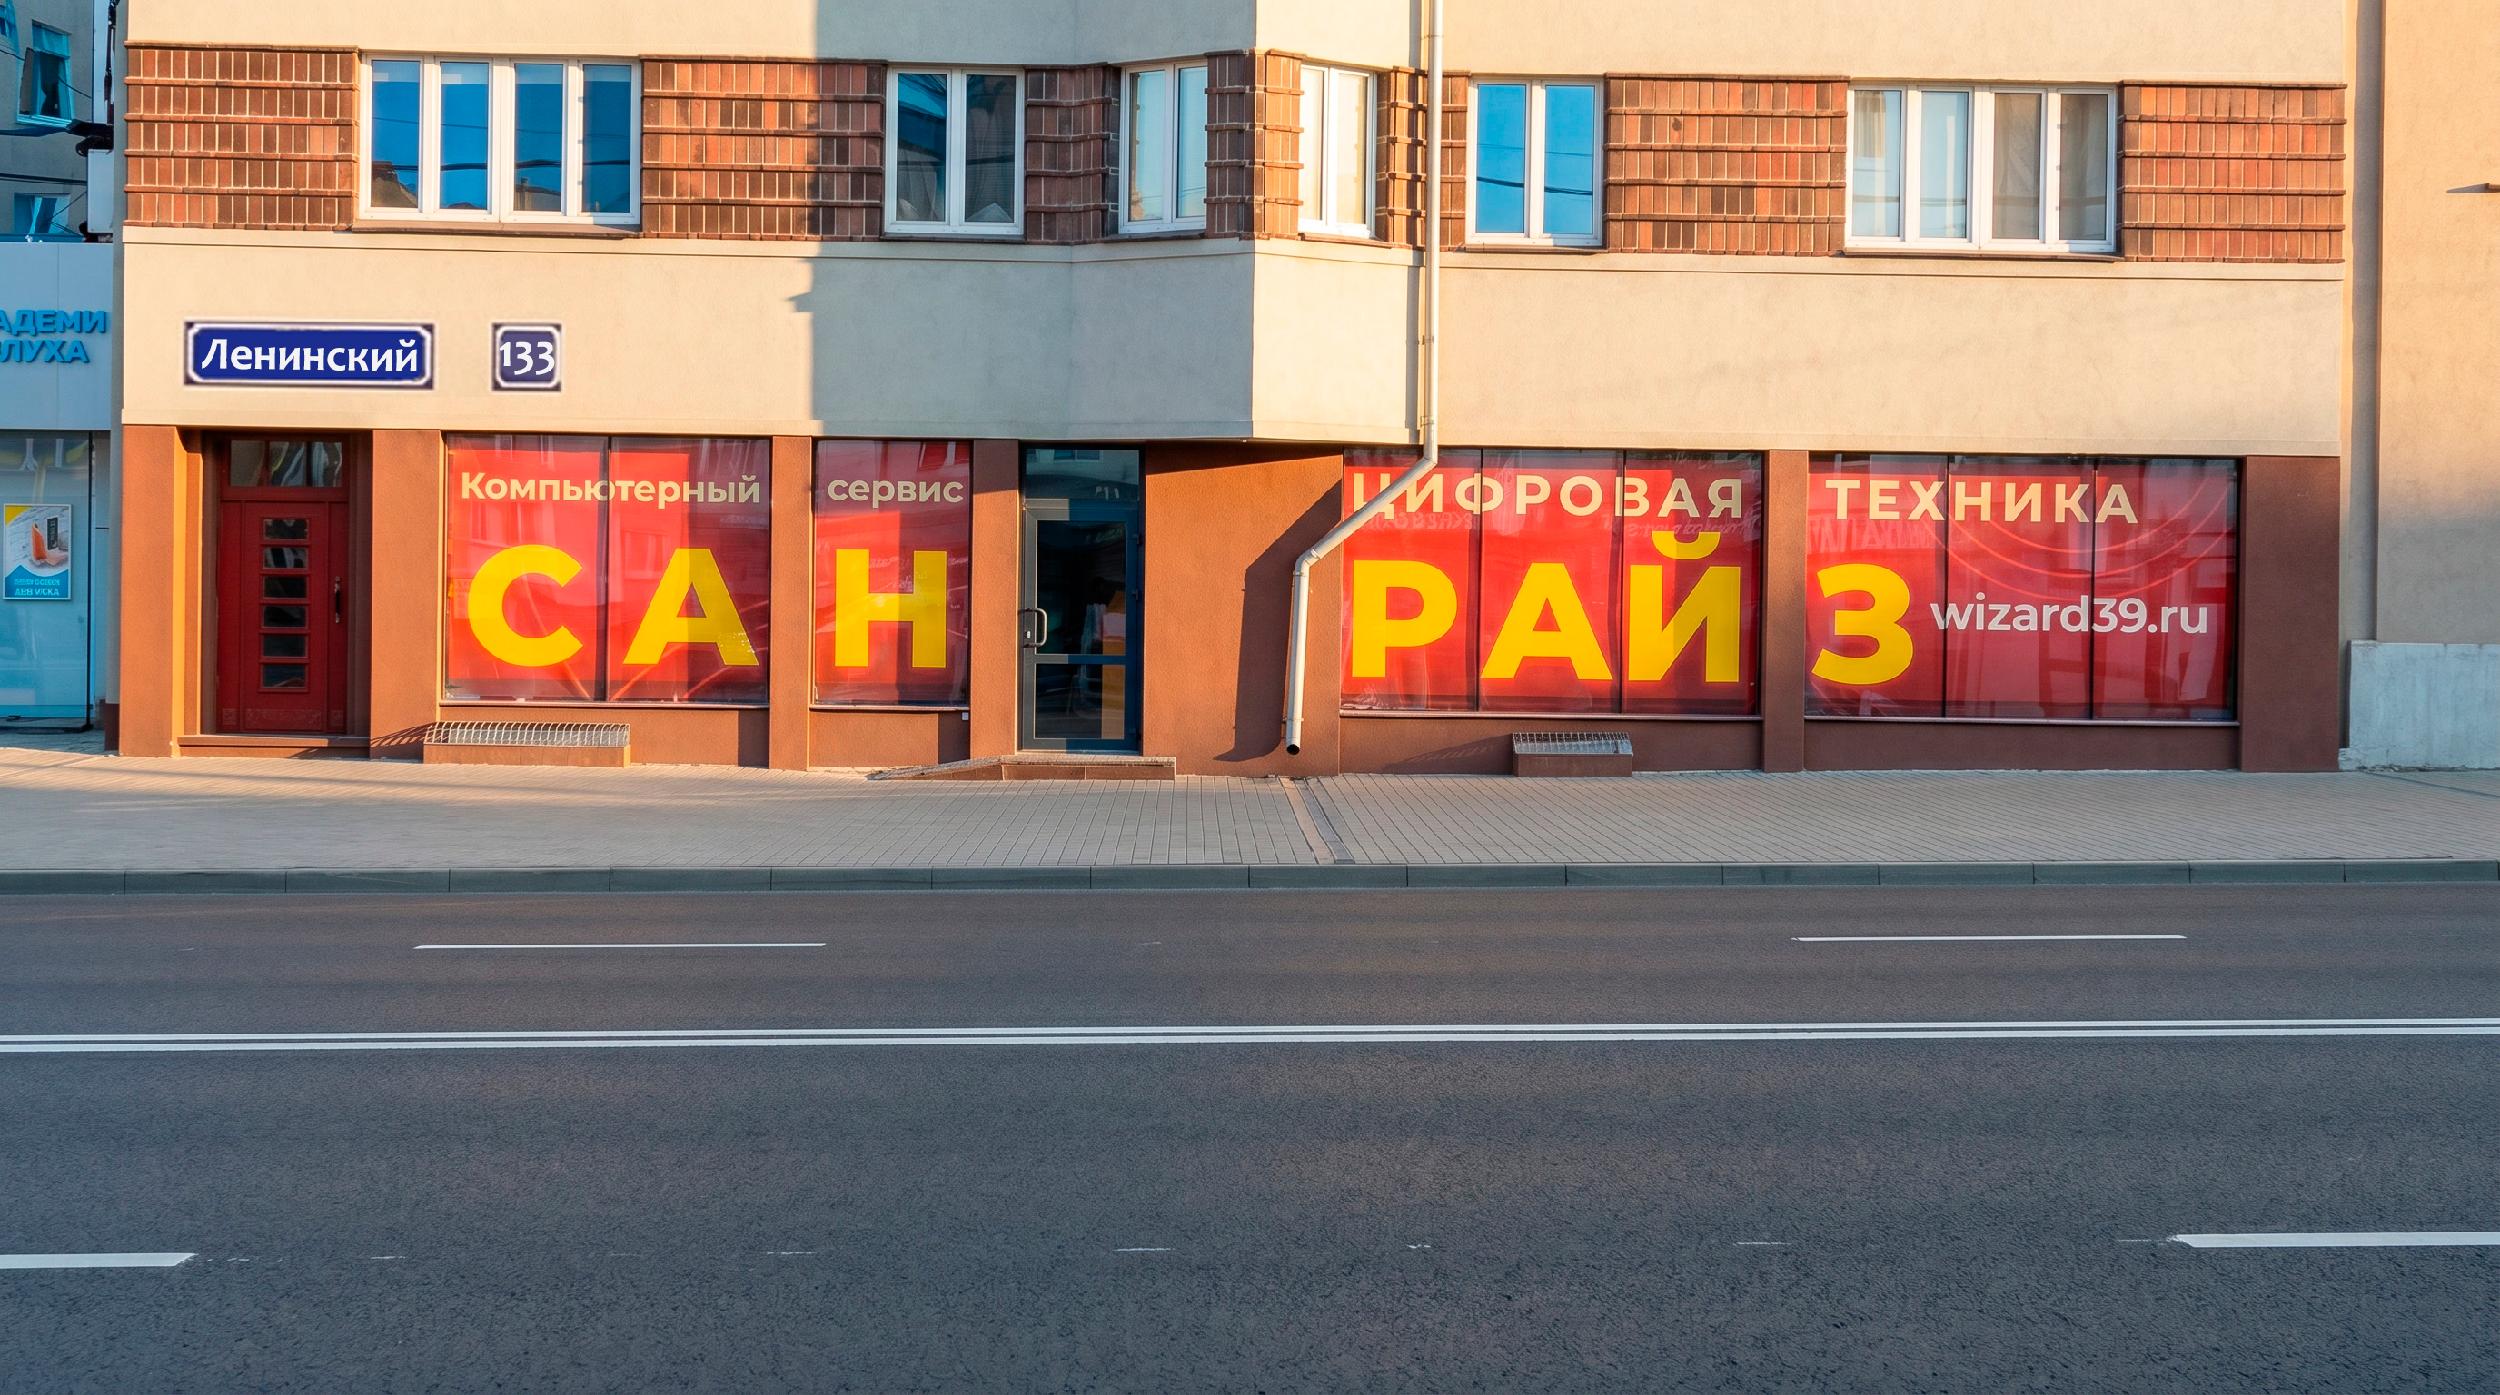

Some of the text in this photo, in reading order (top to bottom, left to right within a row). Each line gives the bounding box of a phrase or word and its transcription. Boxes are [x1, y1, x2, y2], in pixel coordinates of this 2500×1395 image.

[0, 340, 90, 363] ЛУХА
[201, 338, 418, 372] Ленинский
[500, 340, 555, 376] 133
[461, 472, 964, 510] Компьютерный сервис
[1352, 472, 2138, 524] ЦИФРОВАЯ ТЕХНИКА
[467, 544, 948, 669] САН
[1930, 592, 2208, 634] wizard39.ru
